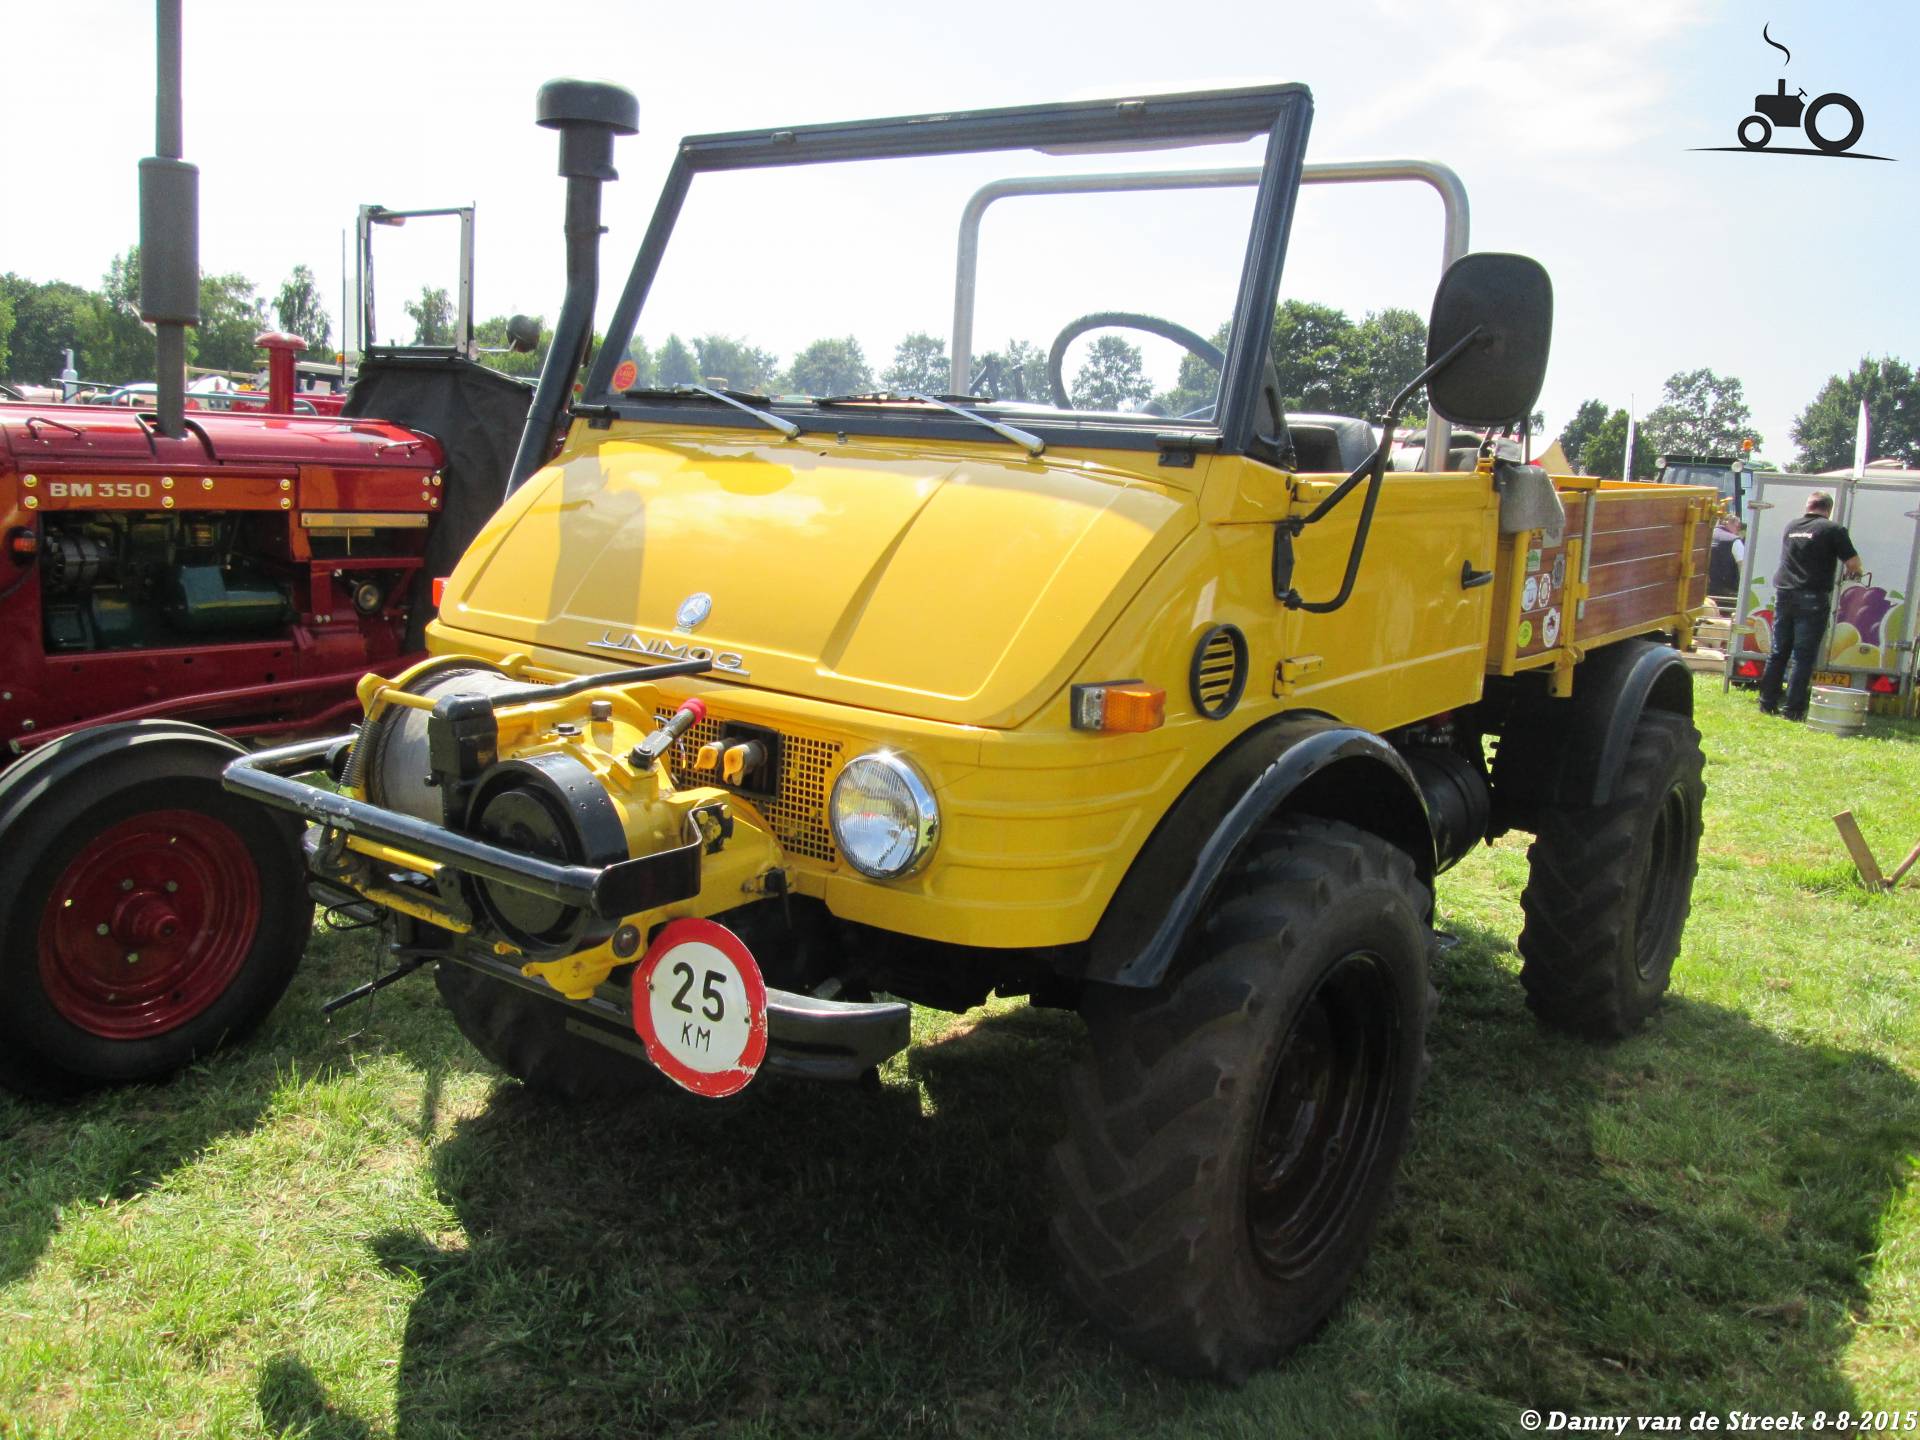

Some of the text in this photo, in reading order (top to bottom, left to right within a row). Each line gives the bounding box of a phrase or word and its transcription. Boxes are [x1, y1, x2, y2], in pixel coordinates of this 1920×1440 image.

[50, 482, 151, 498] BM 350
[602, 630, 743, 669] UNIMOG
[671, 962, 728, 1022] 25
[681, 1021, 711, 1052] KM
